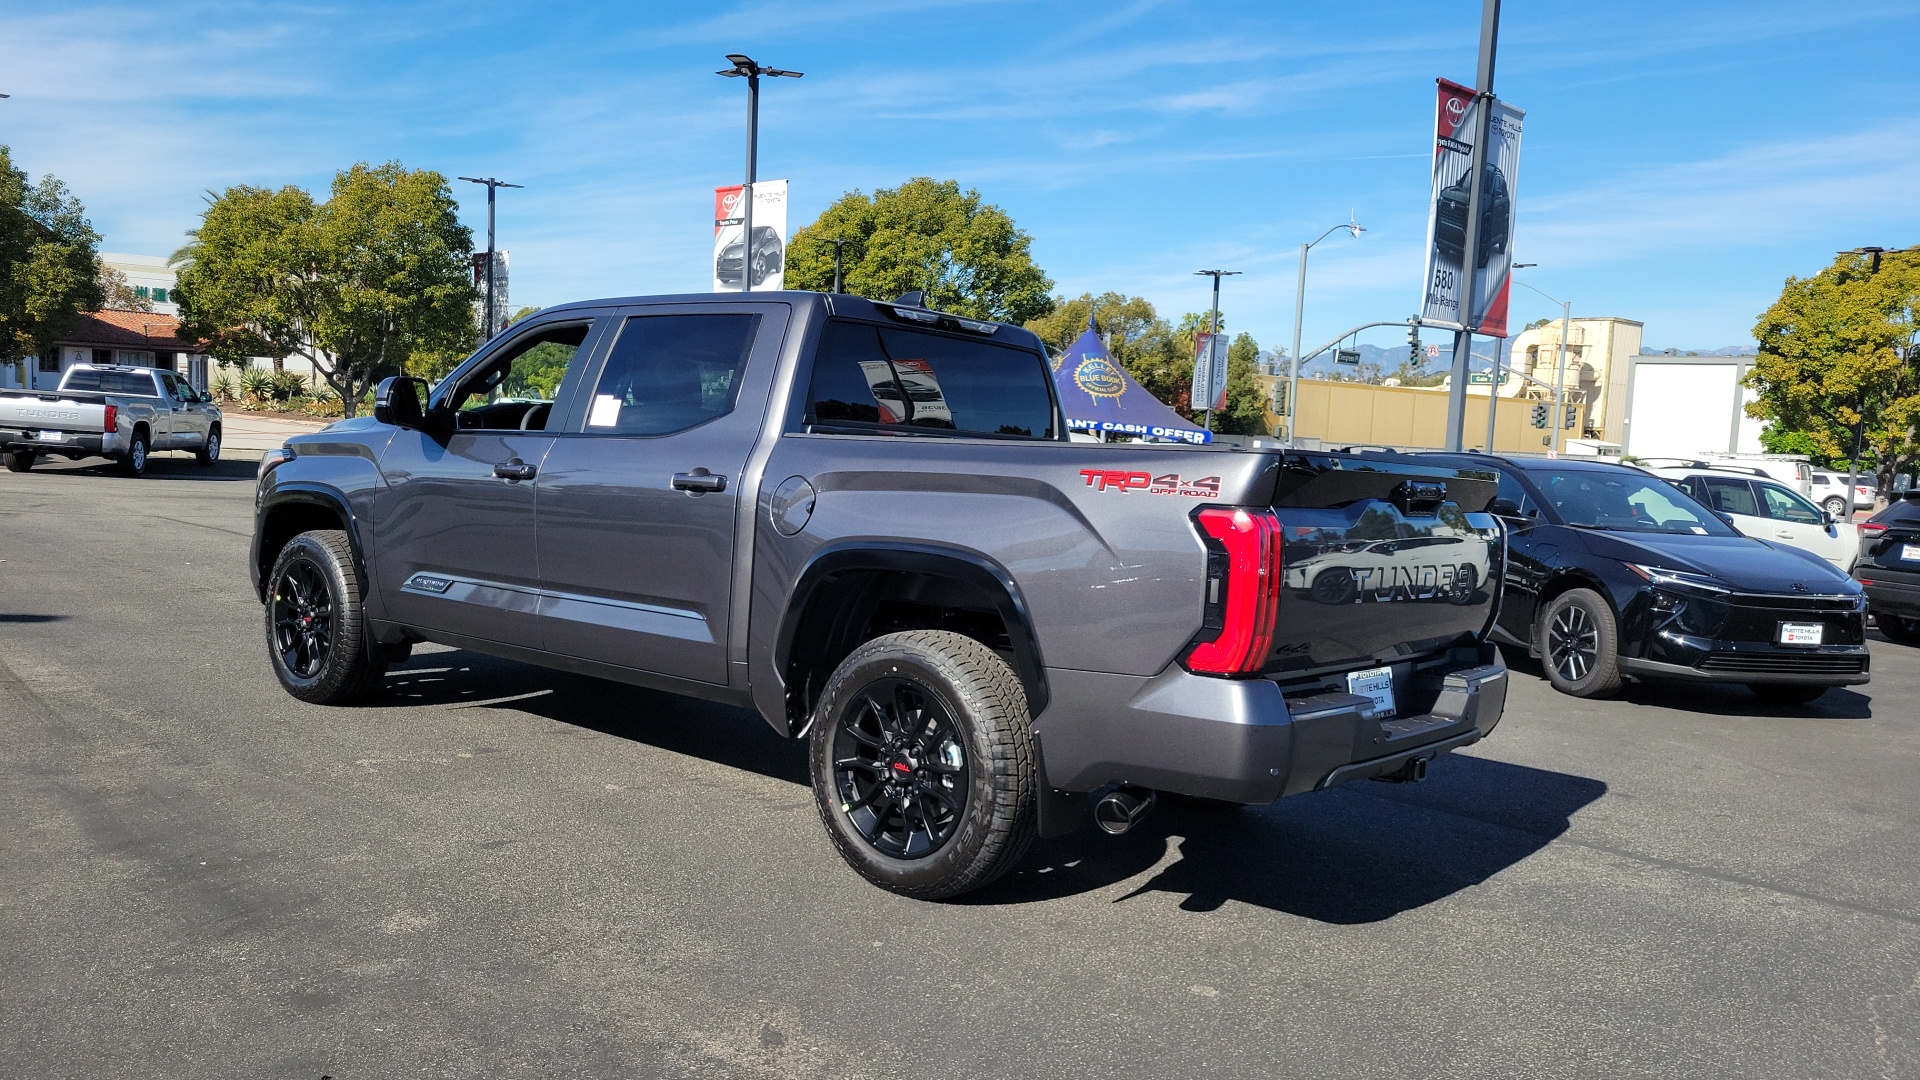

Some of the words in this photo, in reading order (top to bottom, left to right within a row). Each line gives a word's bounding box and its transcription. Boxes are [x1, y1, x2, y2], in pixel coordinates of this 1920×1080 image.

[1490, 116, 1508, 128] UENTE
[1499, 127, 1516, 141] TOYOTA
[1434, 269, 1454, 290] 580
[1338, 352, 1355, 363] Evergreen
[1083, 362, 1117, 376] KELLEY
[1101, 375, 1121, 385] BOOK
[16, 408, 80, 420] TUNDRA
[1065, 419, 1098, 428] ANT
[1102, 422, 1147, 434] CASH
[1152, 427, 1205, 444] OFFER
[1080, 469, 1151, 494] TRD
[1180, 490, 1218, 498] ROAD
[1359, 670, 1382, 679] TOYOTA
[1374, 696, 1385, 705] OTA
